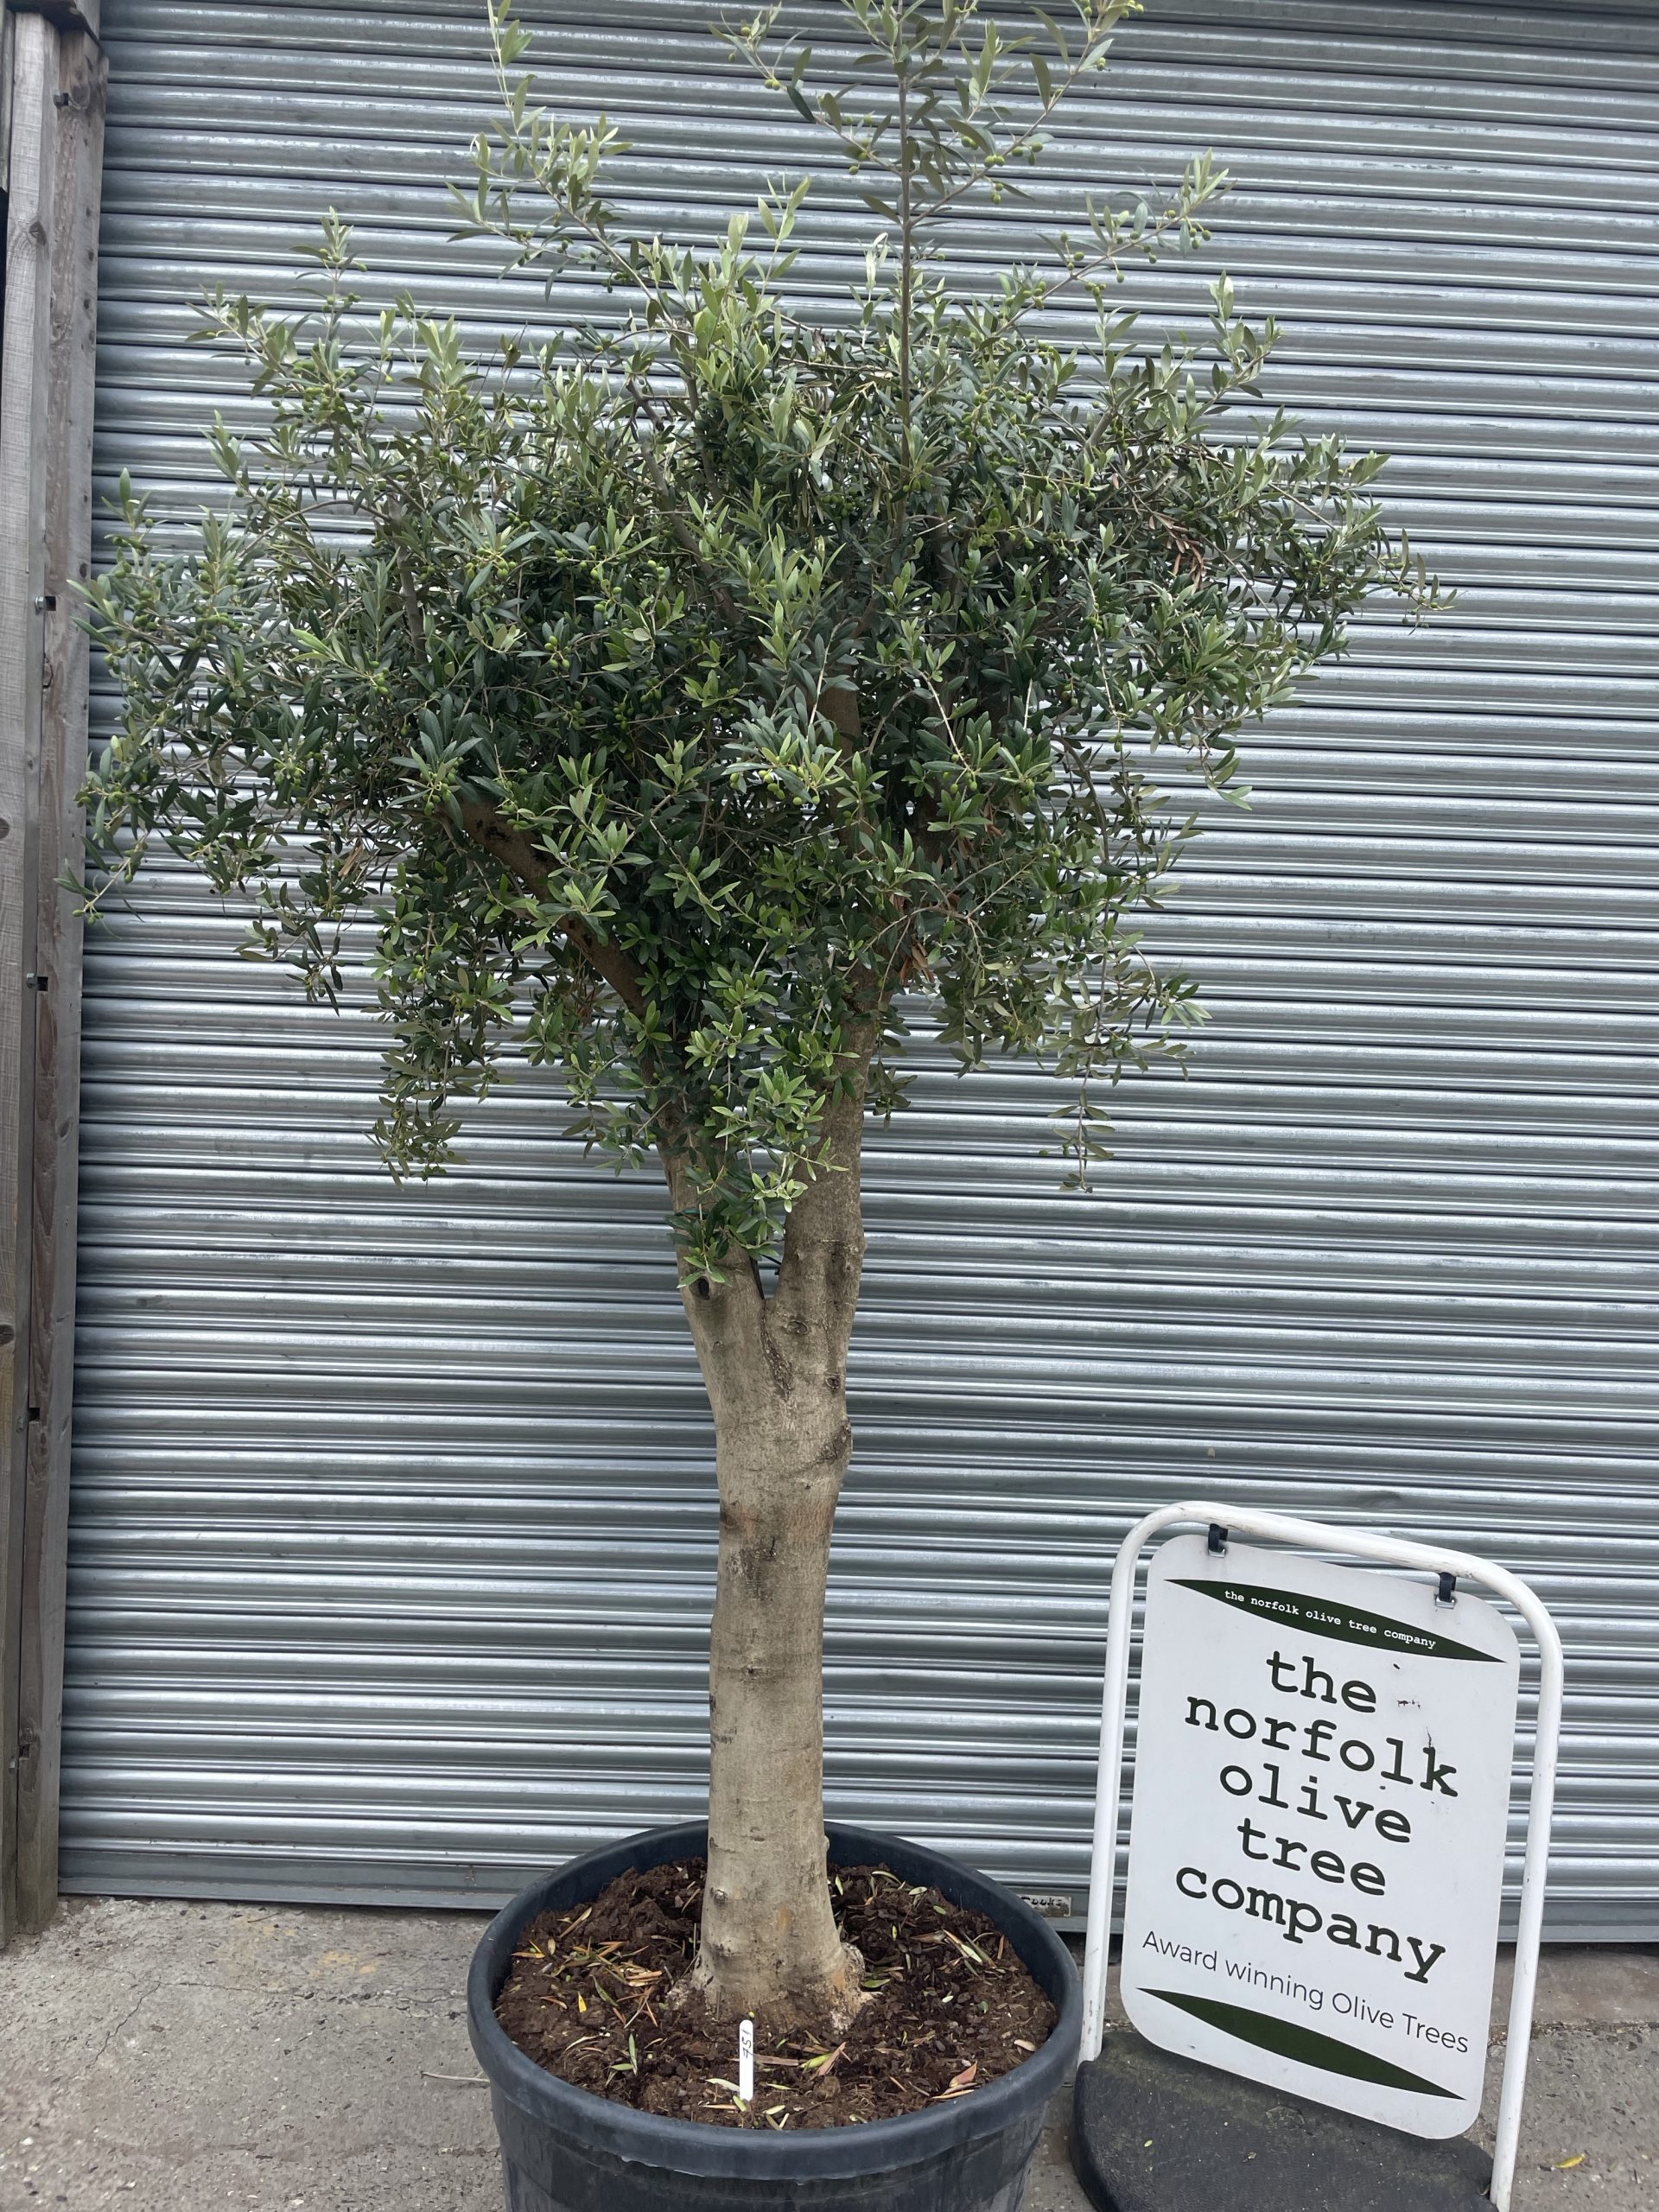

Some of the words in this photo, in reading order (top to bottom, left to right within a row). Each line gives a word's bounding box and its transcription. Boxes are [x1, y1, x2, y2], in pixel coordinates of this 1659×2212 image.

[1224, 1590, 1245, 1602] the
[1250, 1597, 1300, 1615] norfolk
[1306, 1610, 1342, 1625] olive
[1348, 1619, 1377, 1634] tree
[1383, 1629, 1437, 1649] company
[1266, 1650, 1376, 1713] the
[1185, 1696, 1458, 1797] norfolk
[1219, 1764, 1411, 1843] olive
[1236, 1818, 1386, 1896] tree
[1176, 1866, 1446, 1984] company
[1141, 1930, 1217, 1972] Award
[1225, 1960, 1324, 2011] winning
[1332, 1993, 1394, 2029] Olive
[1402, 2012, 1468, 2053] Trees
